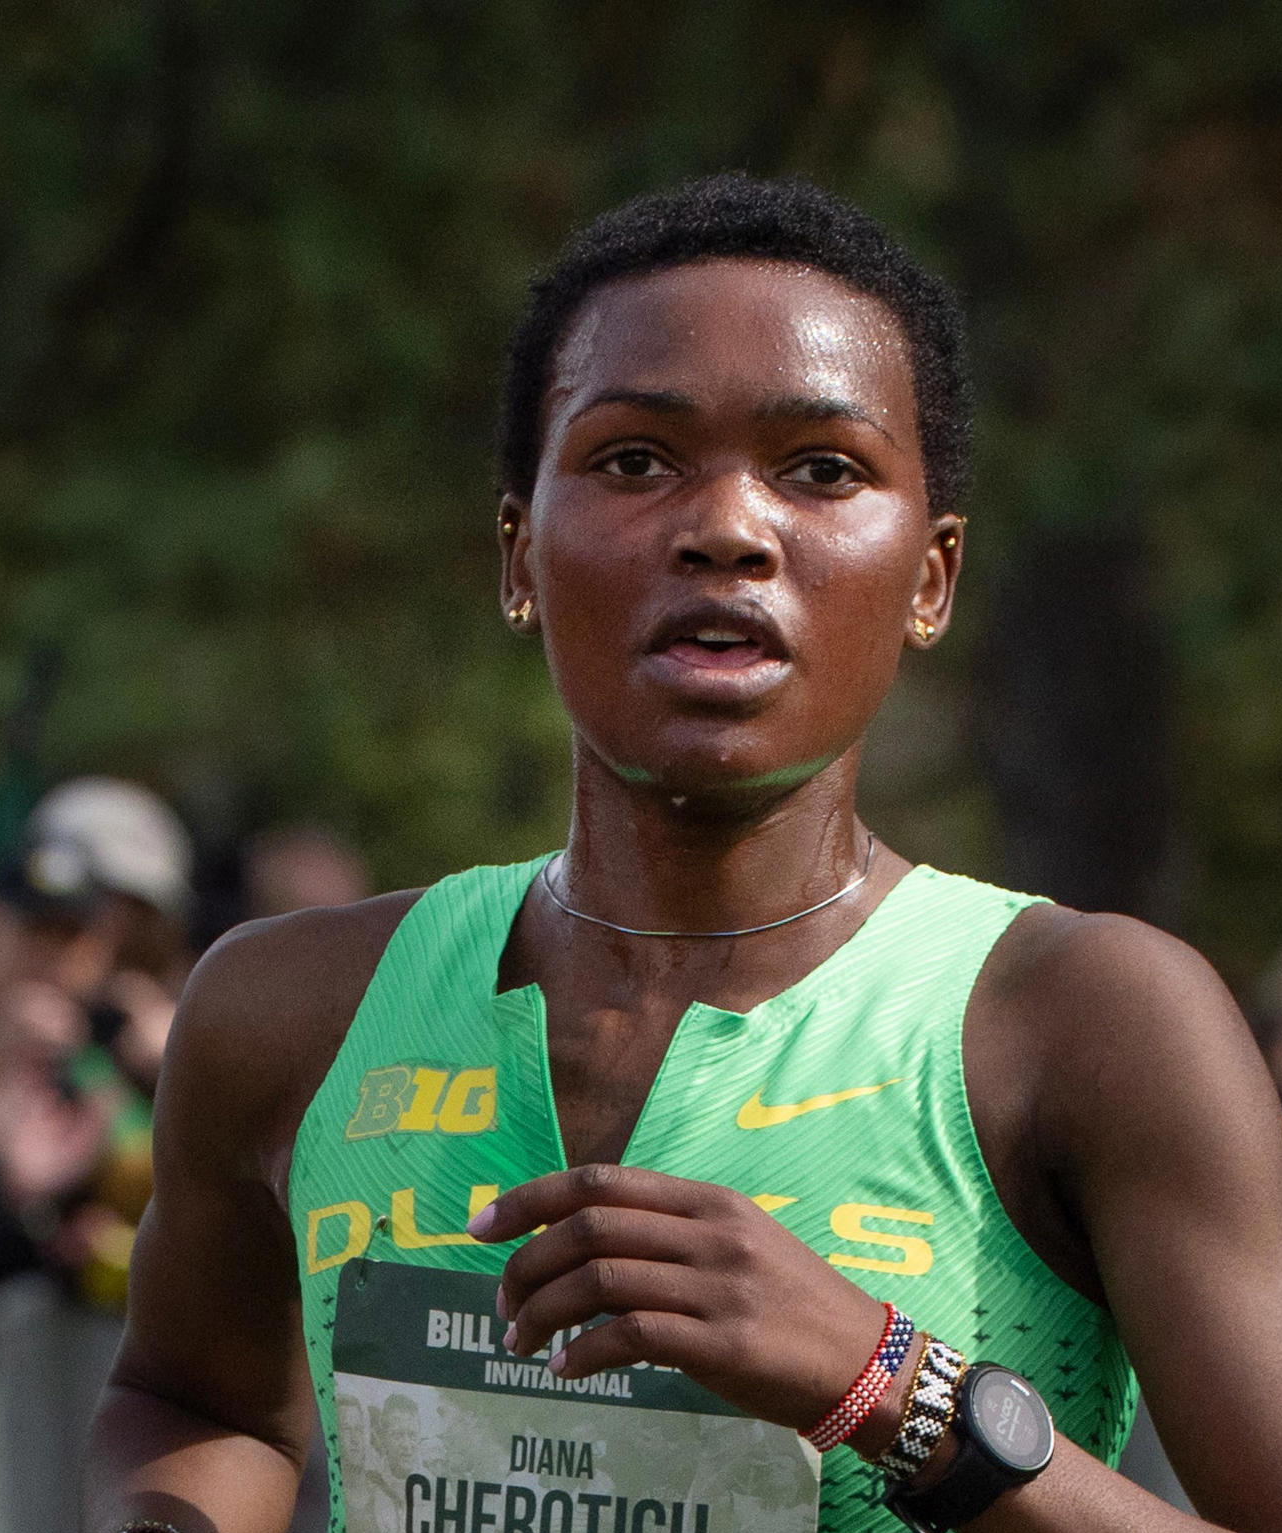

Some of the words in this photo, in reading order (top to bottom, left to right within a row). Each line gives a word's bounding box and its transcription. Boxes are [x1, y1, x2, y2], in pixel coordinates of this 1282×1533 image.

[307, 1184, 934, 1276] DUS
[426, 1309, 495, 1353] BILL
[510, 1435, 593, 1479] DIANA
